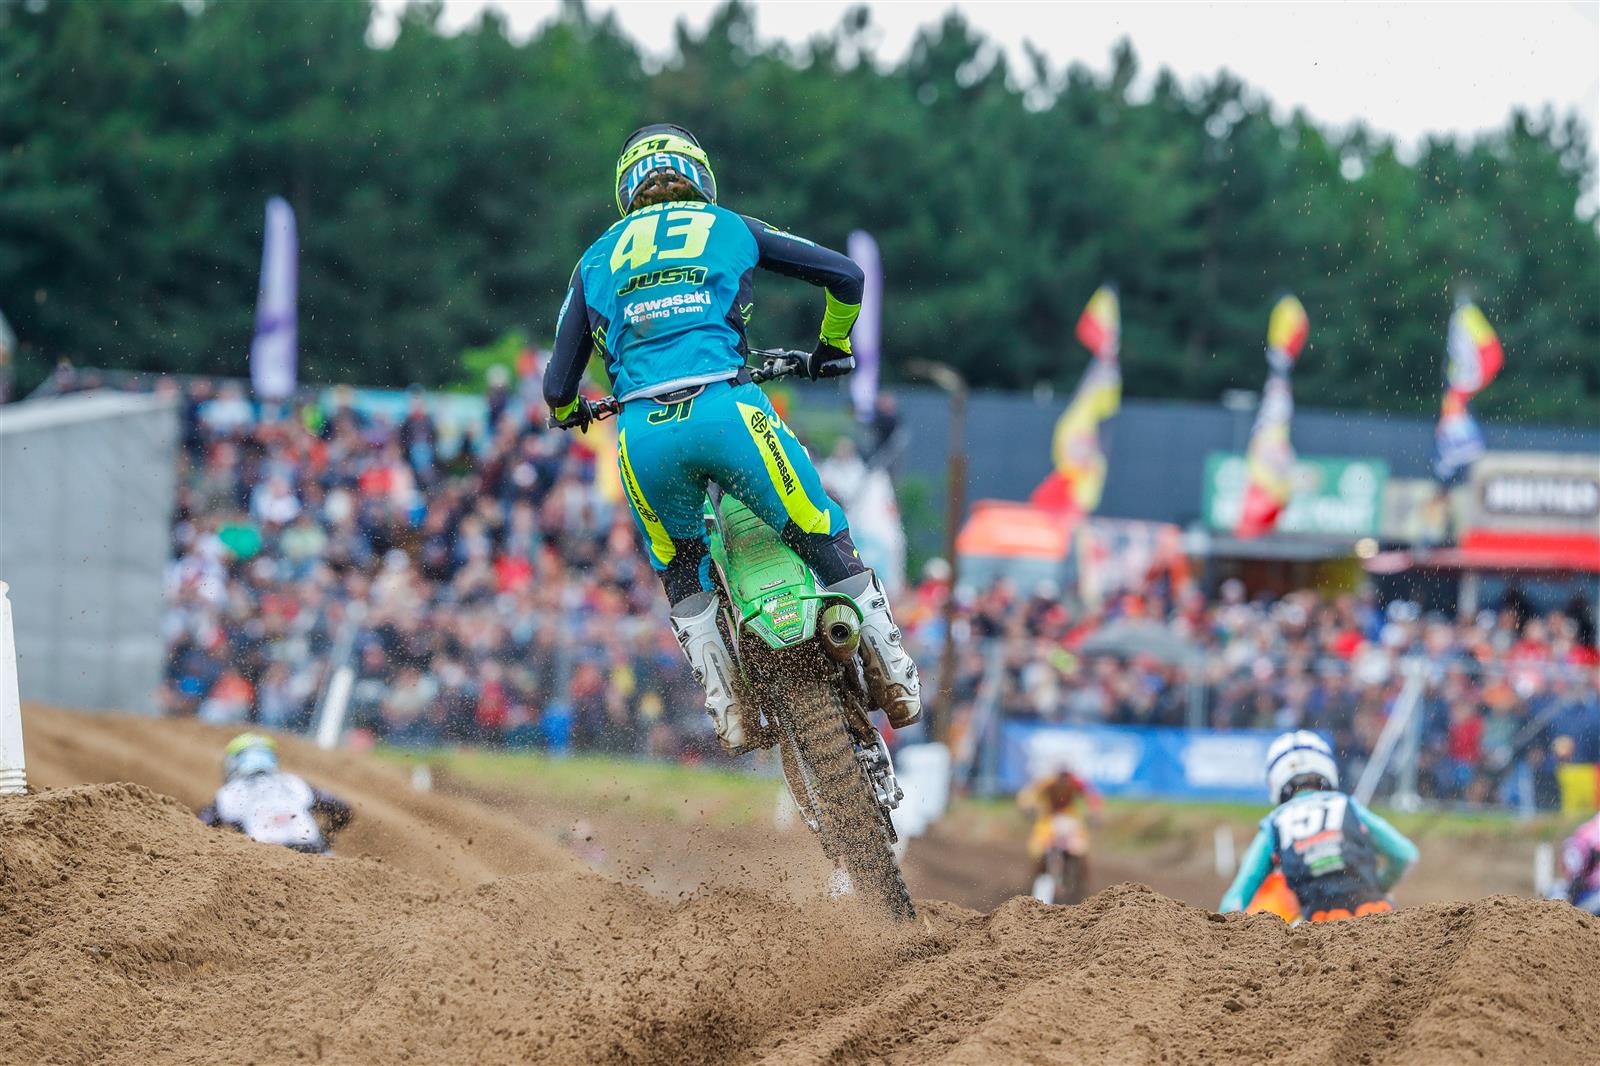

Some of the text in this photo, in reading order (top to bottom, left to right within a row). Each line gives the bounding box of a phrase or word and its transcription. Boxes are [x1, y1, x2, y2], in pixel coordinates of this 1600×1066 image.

[610, 210, 716, 275] 43
[617, 265, 708, 296] JUST1
[623, 291, 711, 320] Kawasaki
[630, 305, 704, 324] Racing Team
[763, 429, 797, 496] Kawasaki
[1276, 796, 1347, 850] 151
